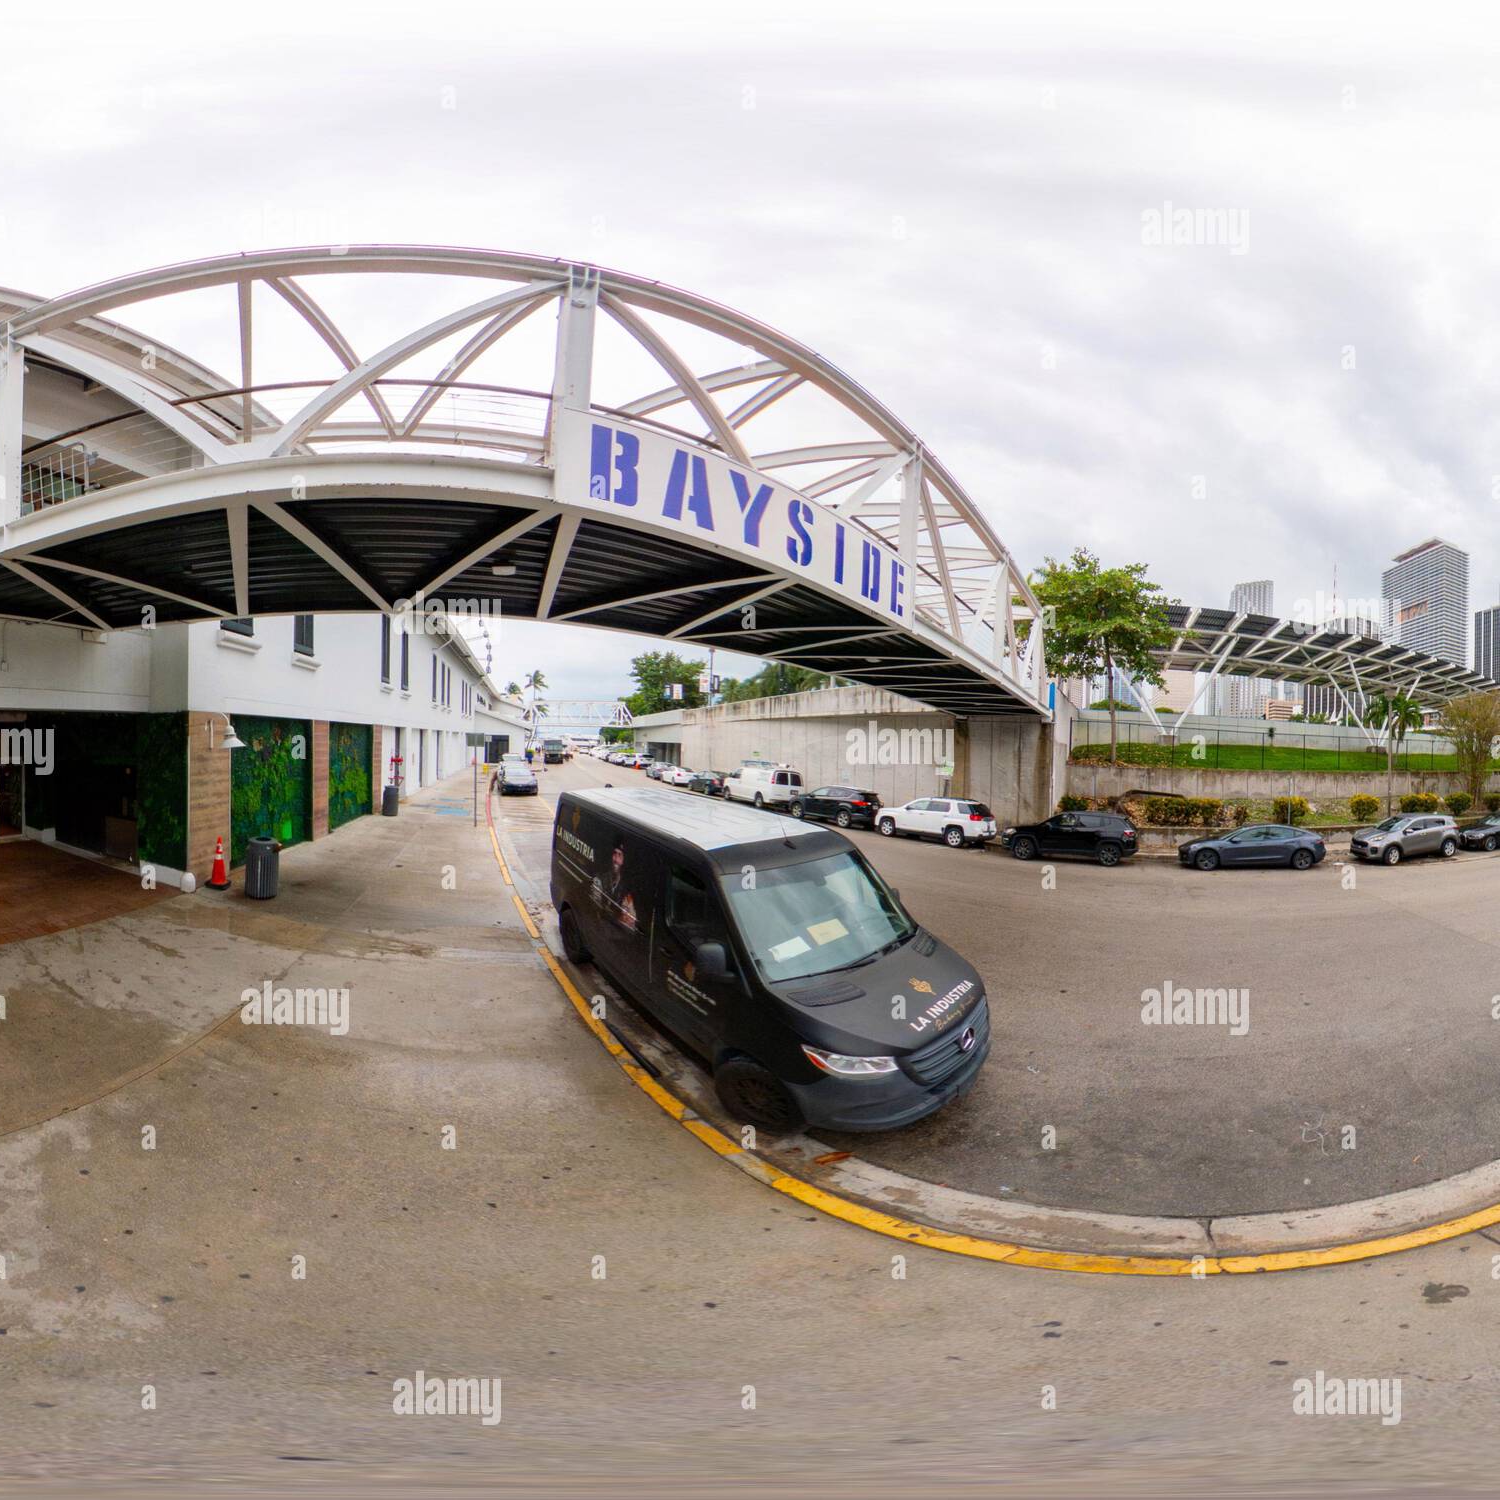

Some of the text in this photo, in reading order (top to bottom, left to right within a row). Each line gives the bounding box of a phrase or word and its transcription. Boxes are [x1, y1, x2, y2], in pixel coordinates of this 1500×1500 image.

[590, 424, 904, 617] BAYSIDE
[556, 824, 563, 839] LA
[563, 829, 594, 862] INDUSTRIA
[910, 1016, 931, 1032] LA
[926, 980, 974, 1018] INDUSTRIA
